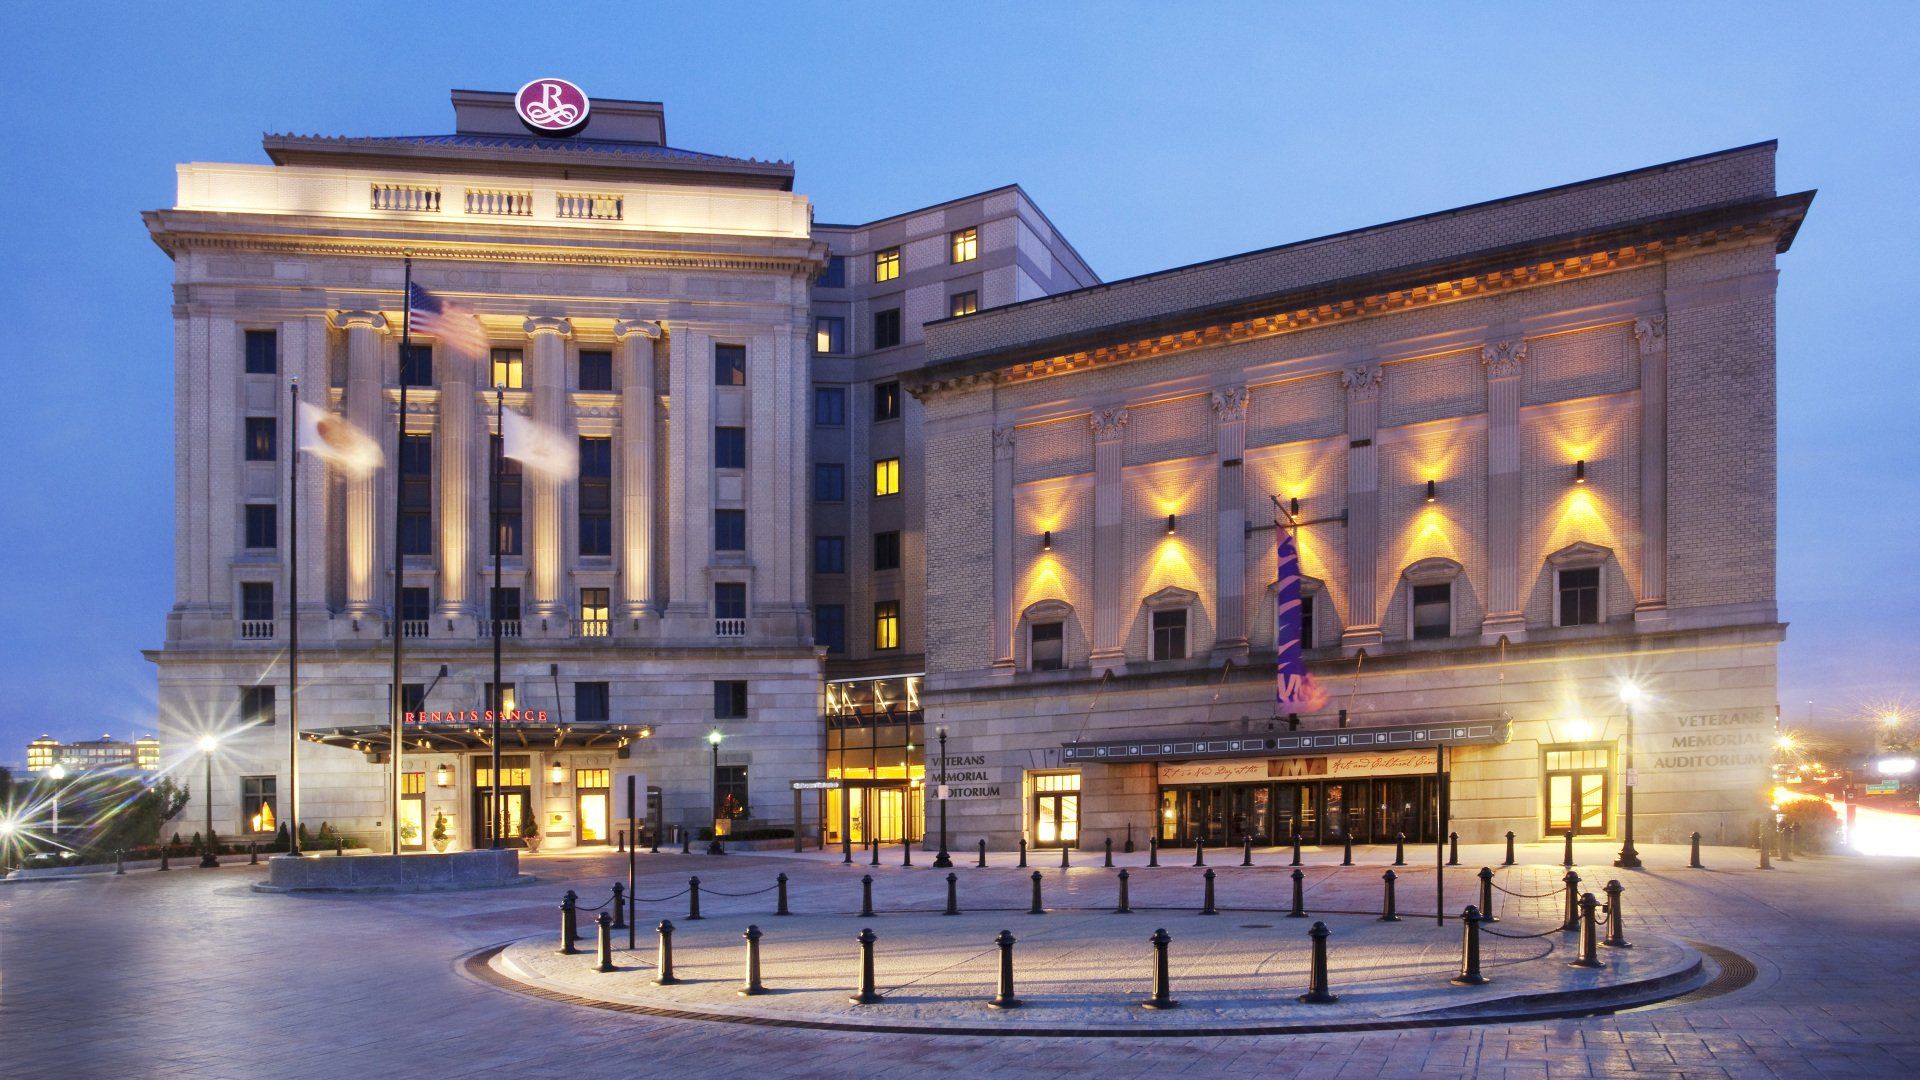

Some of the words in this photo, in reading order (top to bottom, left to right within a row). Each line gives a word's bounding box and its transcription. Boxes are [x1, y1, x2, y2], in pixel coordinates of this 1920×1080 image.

[405, 711, 547, 722] RENAISSANCE
[1677, 711, 1766, 728] VETERANS
[1671, 732, 1765, 749] MEMORIAL
[931, 756, 985, 766] VTERANS
[1654, 754, 1764, 769] AUDITORIUM
[1215, 765, 1233, 780] Day
[1353, 758, 1370, 769] and
[931, 772, 988, 782] MMORIAL
[931, 786, 1000, 799] ADITORIUM
